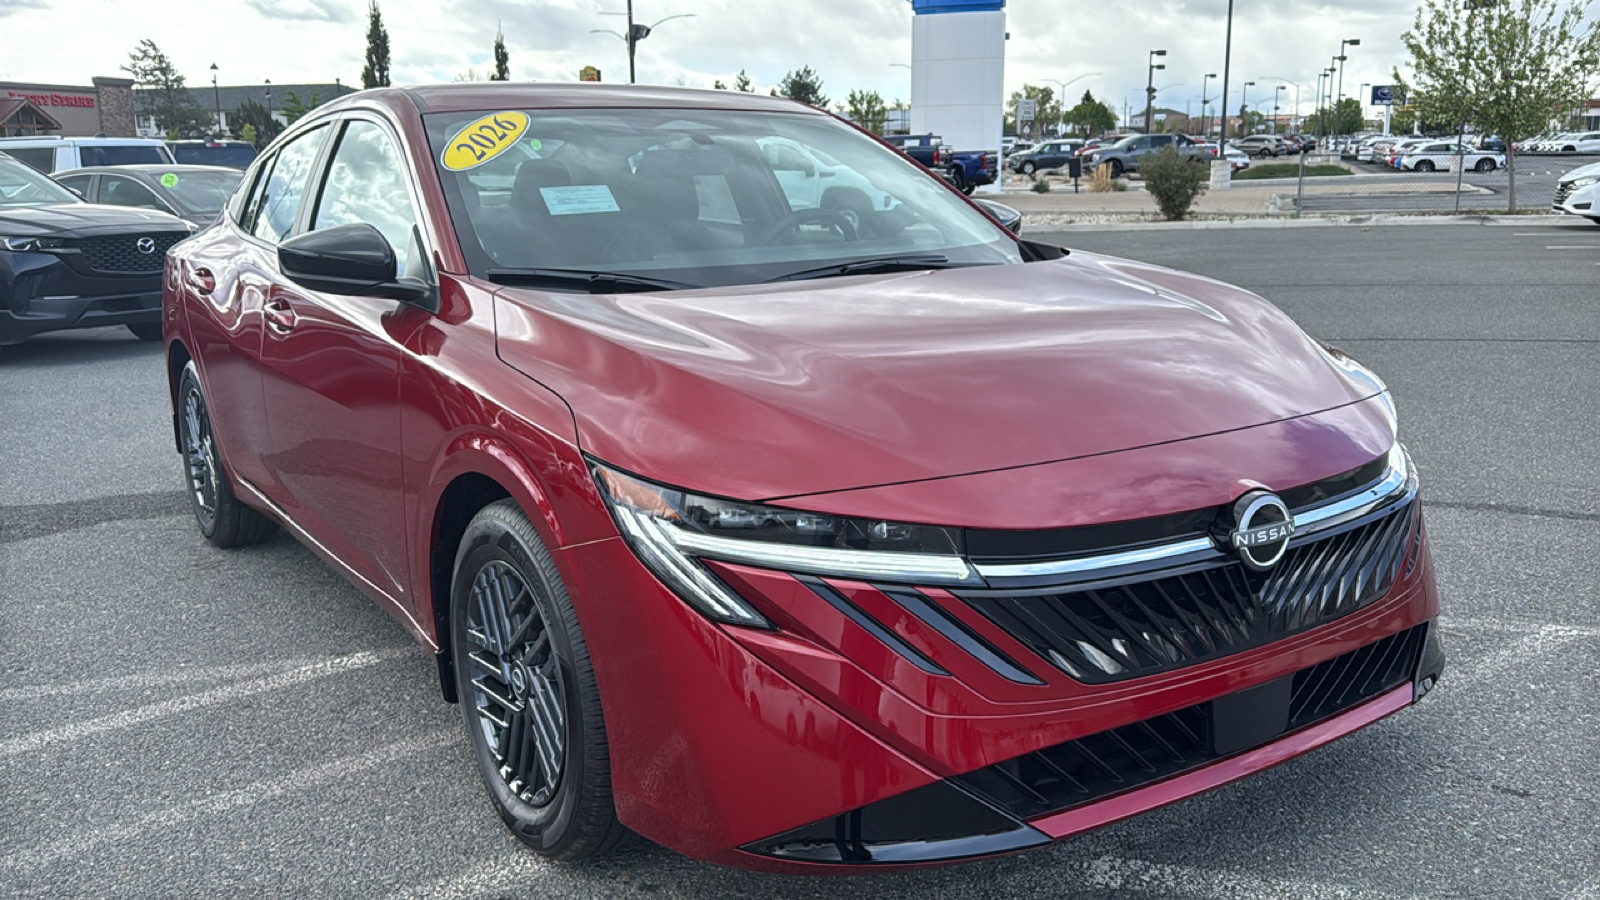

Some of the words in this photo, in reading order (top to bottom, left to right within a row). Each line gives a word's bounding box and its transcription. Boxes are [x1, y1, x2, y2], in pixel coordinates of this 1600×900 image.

[51, 93, 95, 108] STRIKE
[456, 115, 518, 161] 2026
[1236, 523, 1295, 546] NISSAN
